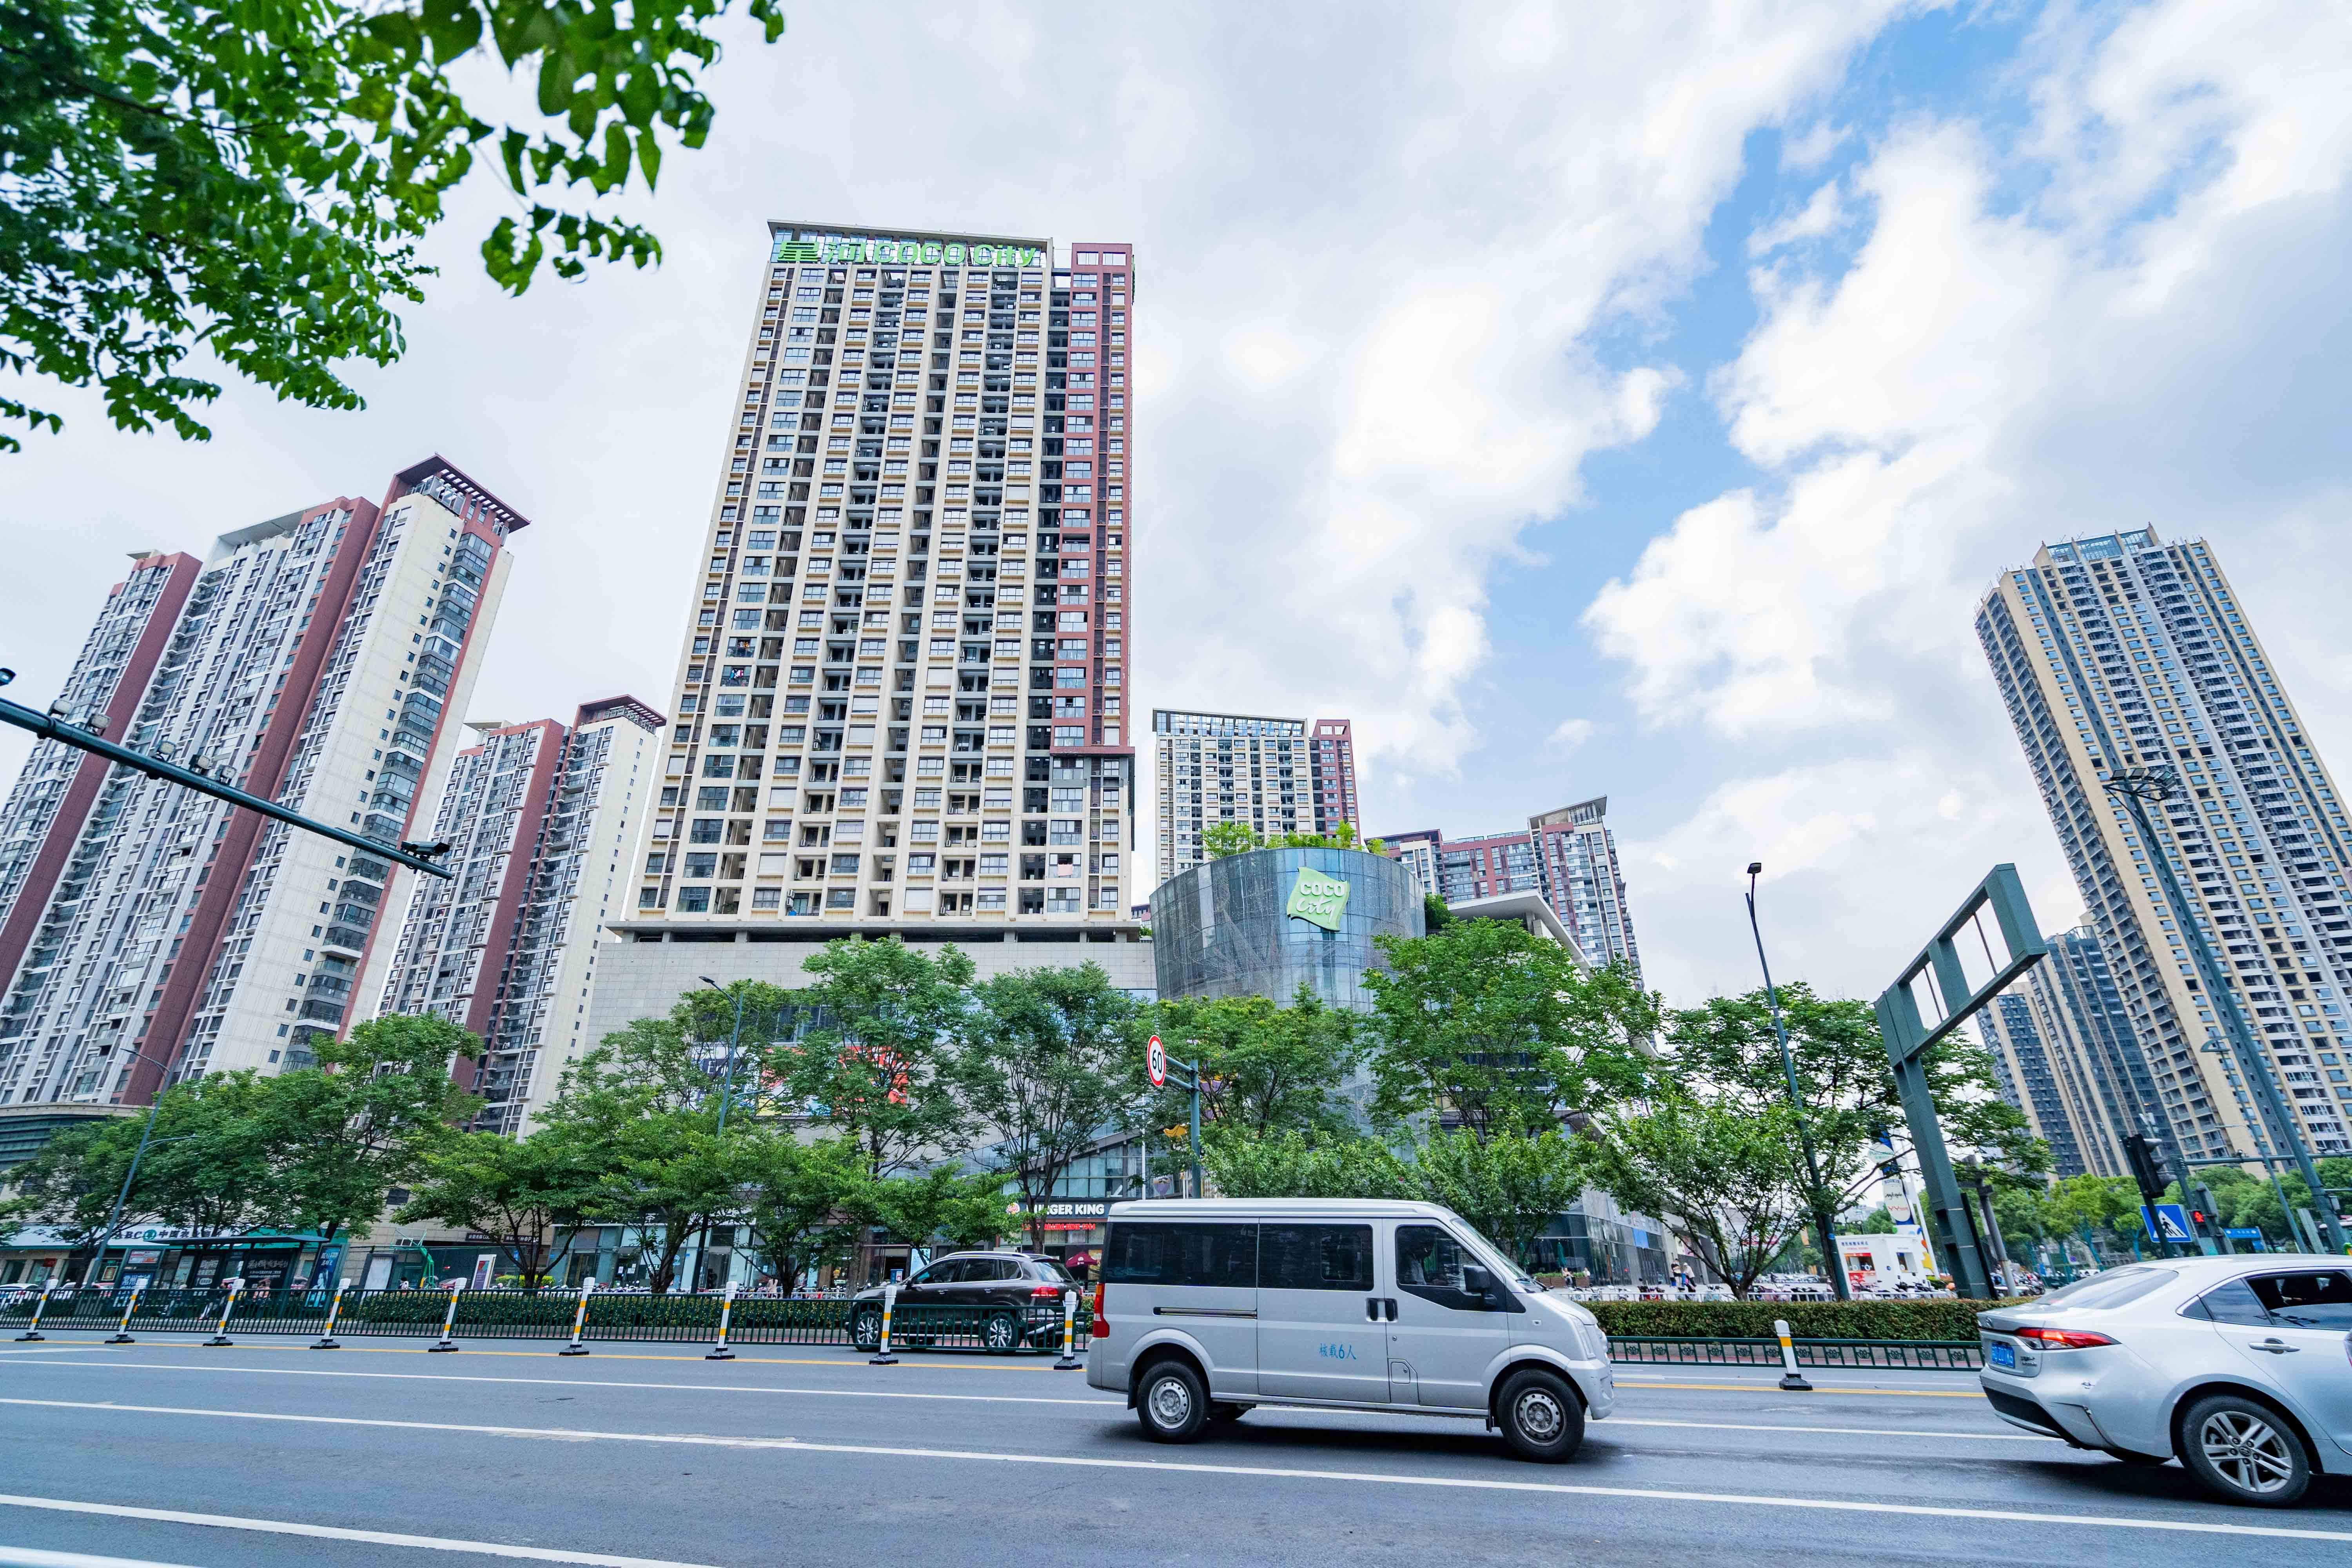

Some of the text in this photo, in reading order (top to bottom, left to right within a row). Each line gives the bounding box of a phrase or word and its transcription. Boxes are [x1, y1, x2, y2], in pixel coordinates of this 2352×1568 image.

[778, 240, 1036, 267] 星河 COCO City
[1301, 881, 1344, 897] COCO
[1296, 896, 1336, 923] City
[1152, 1049, 1162, 1073] 60
[1026, 1204, 1073, 1215] UGER
[1075, 1204, 1104, 1215] KING
[1319, 1342, 1357, 1360] 核载6人
